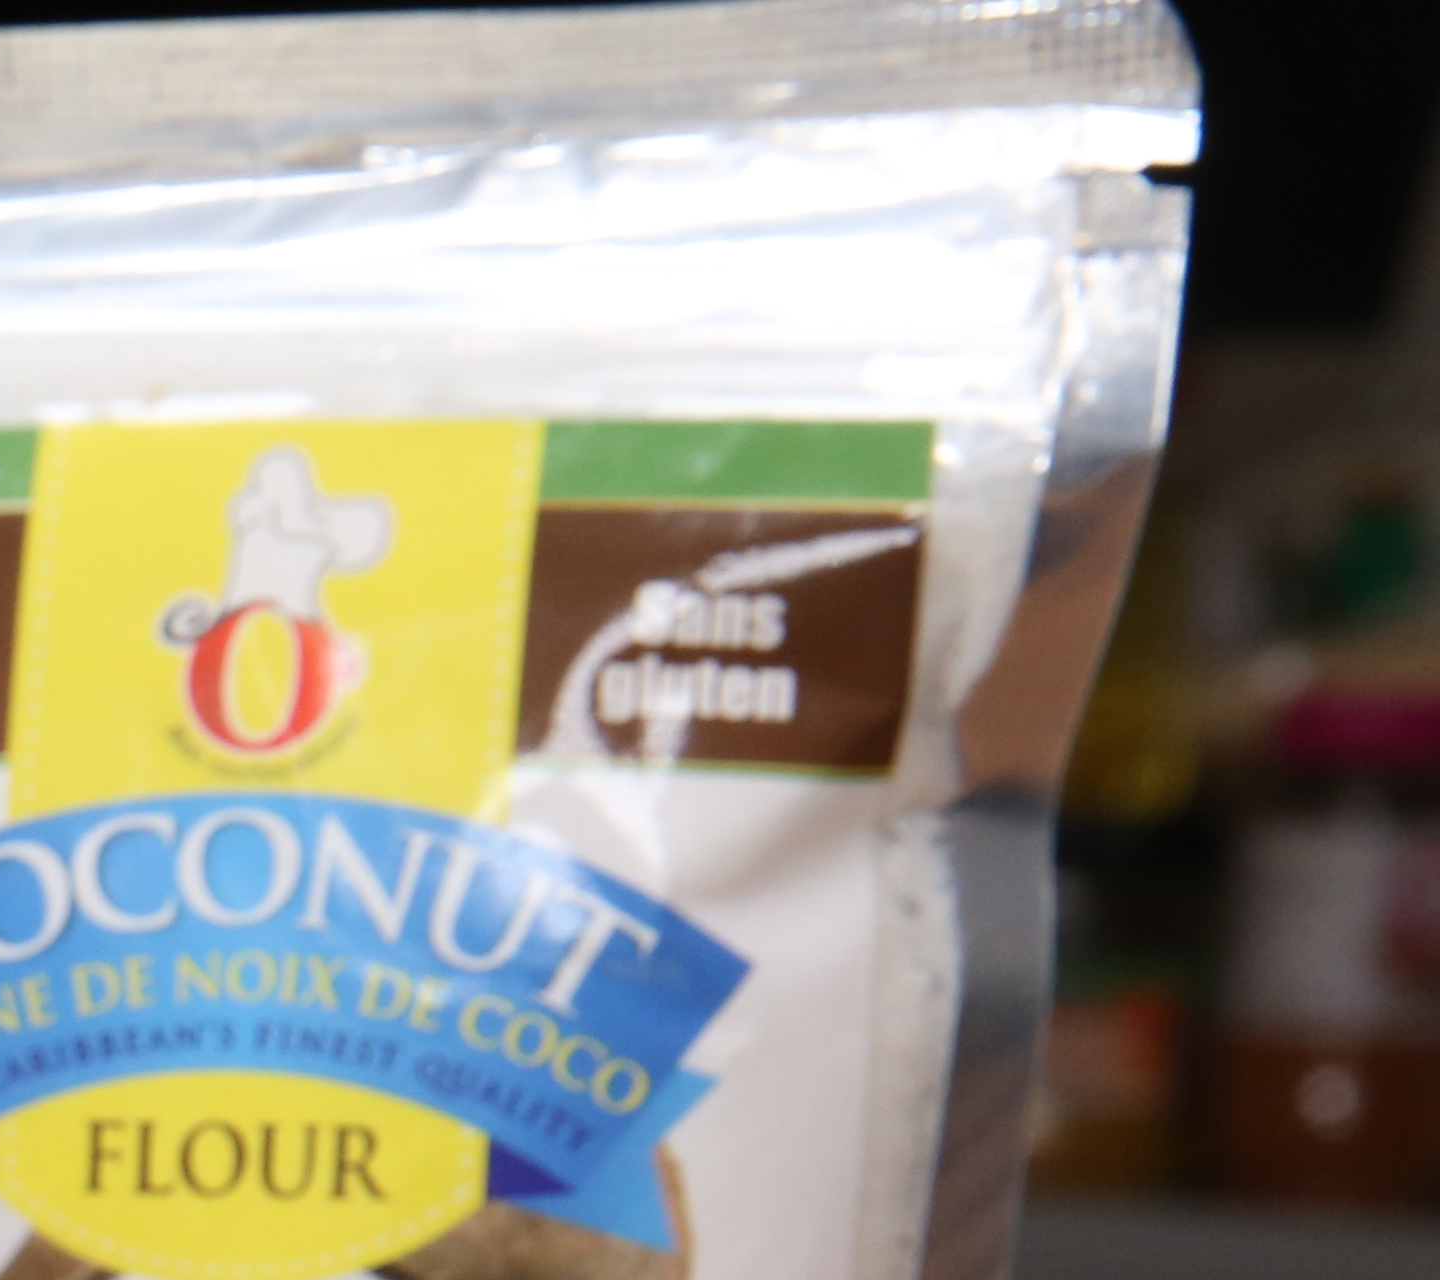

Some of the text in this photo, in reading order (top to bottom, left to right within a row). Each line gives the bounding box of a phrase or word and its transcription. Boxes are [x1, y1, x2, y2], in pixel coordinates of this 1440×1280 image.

[598, 650, 797, 723] gluten
[70, 953, 158, 1018] DE
[175, 947, 346, 1011] NOIX
[357, 961, 451, 1033] DE
[458, 993, 652, 1117] COCO
[85, 1115, 390, 1202] FLOUR
